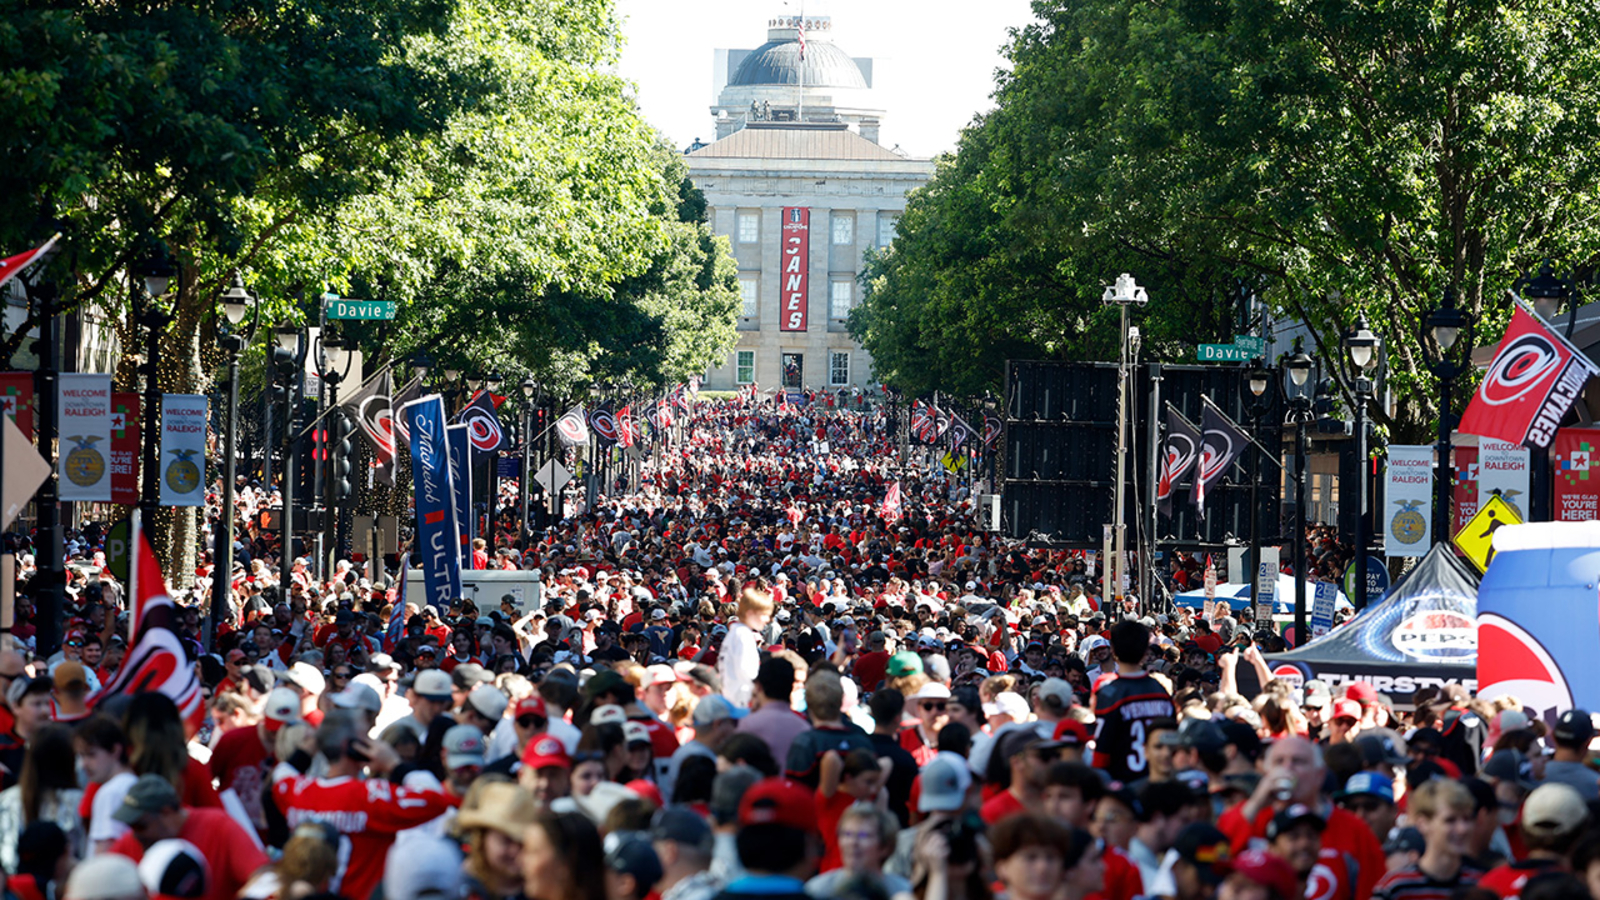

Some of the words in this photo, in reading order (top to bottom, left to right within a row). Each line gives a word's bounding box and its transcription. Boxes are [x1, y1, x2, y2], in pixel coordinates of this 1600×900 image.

[786, 237, 803, 329] CANES
[338, 303, 381, 317] Davie
[1205, 346, 1248, 359] Davie
[62, 389, 107, 397] WELCOME
[64, 408, 106, 416] RALEIGH
[166, 425, 202, 433] RALEIGH
[1483, 443, 1526, 451] WELCOME
[110, 456, 132, 464] OU'RE
[110, 465, 132, 474] ERE!
[1484, 462, 1525, 470] RALEIGH
[1392, 476, 1428, 484] RALEIGH
[1561, 500, 1598, 509] YOU'RE
[415, 413, 441, 504] Michelob
[431, 530, 451, 616] ULTRA
[1460, 507, 1477, 516] YOU
[1561, 510, 1597, 520] HERE!
[110, 539, 125, 562] P
[1317, 583, 1324, 599] 2
[1401, 633, 1476, 645] PEPS
